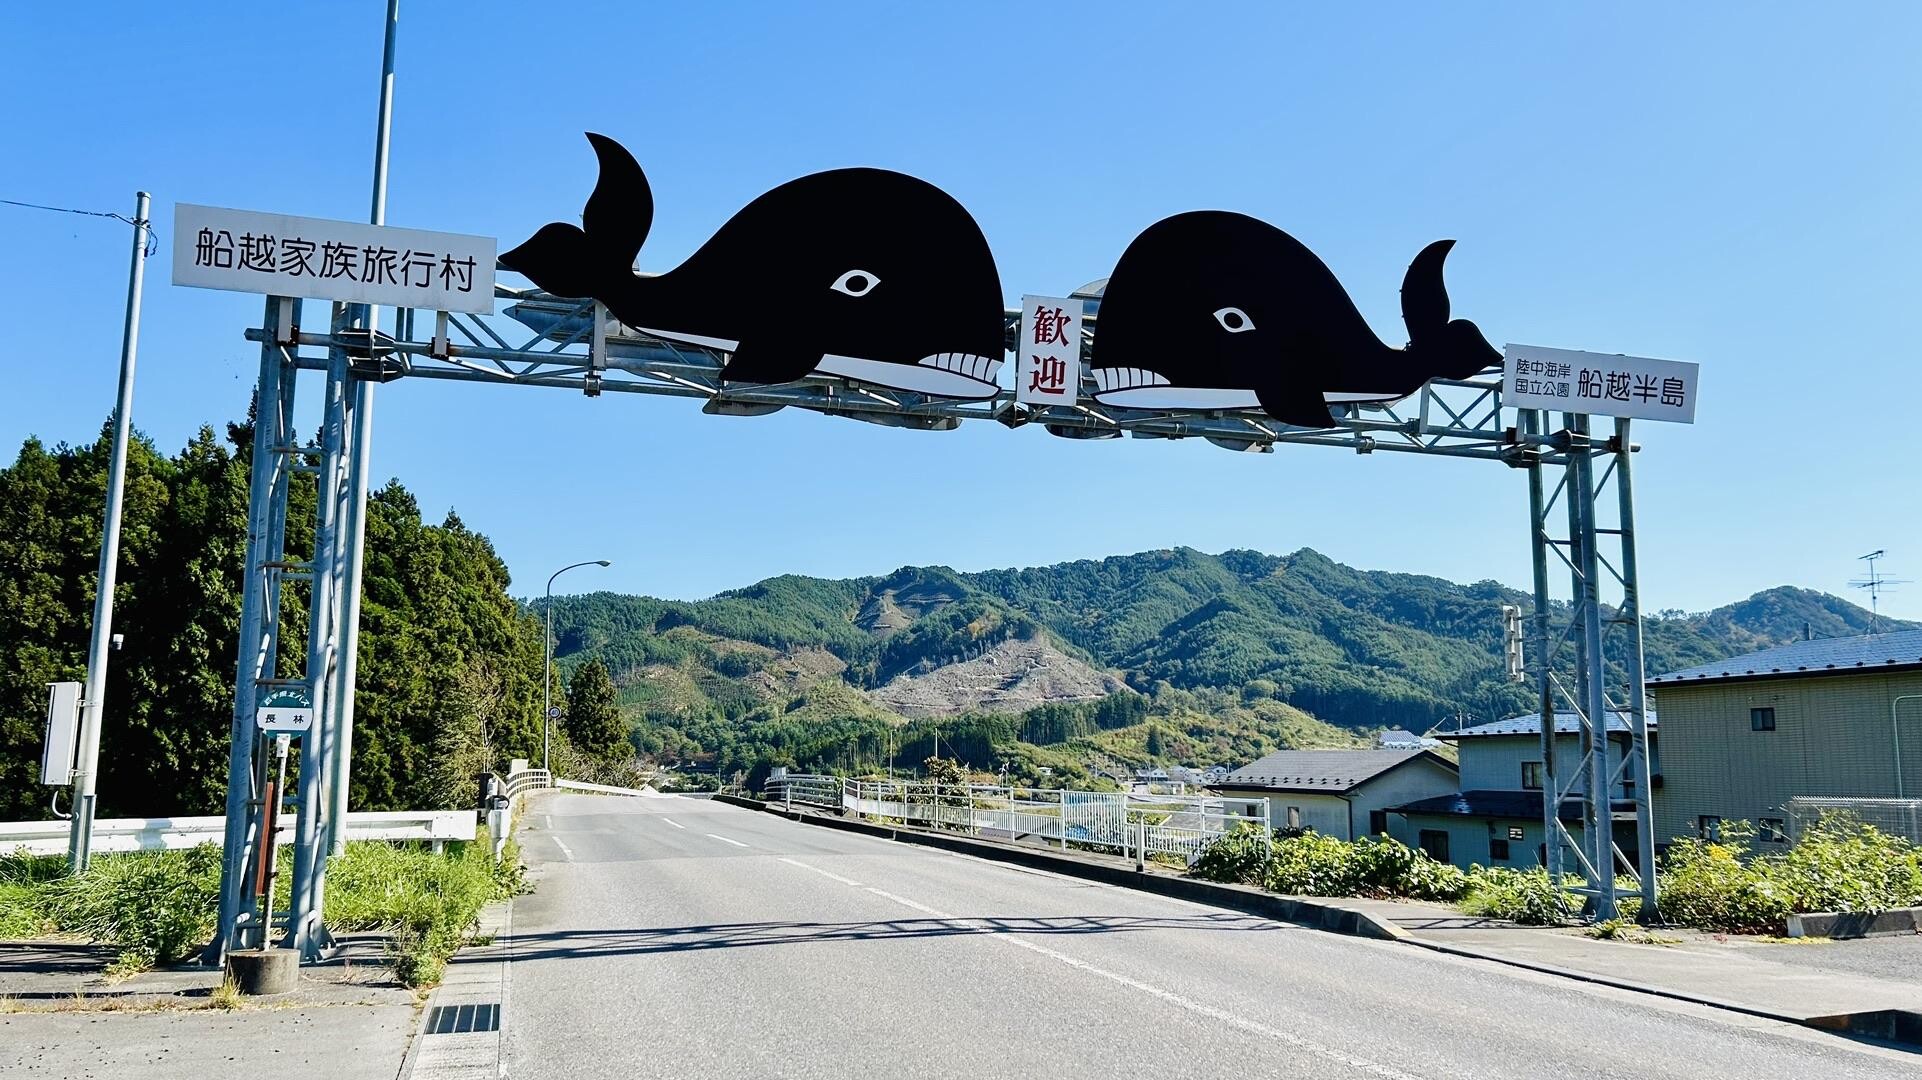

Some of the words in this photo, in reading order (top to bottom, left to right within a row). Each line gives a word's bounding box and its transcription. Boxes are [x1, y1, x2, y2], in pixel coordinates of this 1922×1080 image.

[195, 227, 477, 293] 船越家族旅行村
[1028, 305, 1072, 395] 歓迎
[1516, 358, 1571, 379] 陸中海岸
[1515, 378, 1570, 398] 国立公園
[1577, 367, 1685, 408] 船越半島
